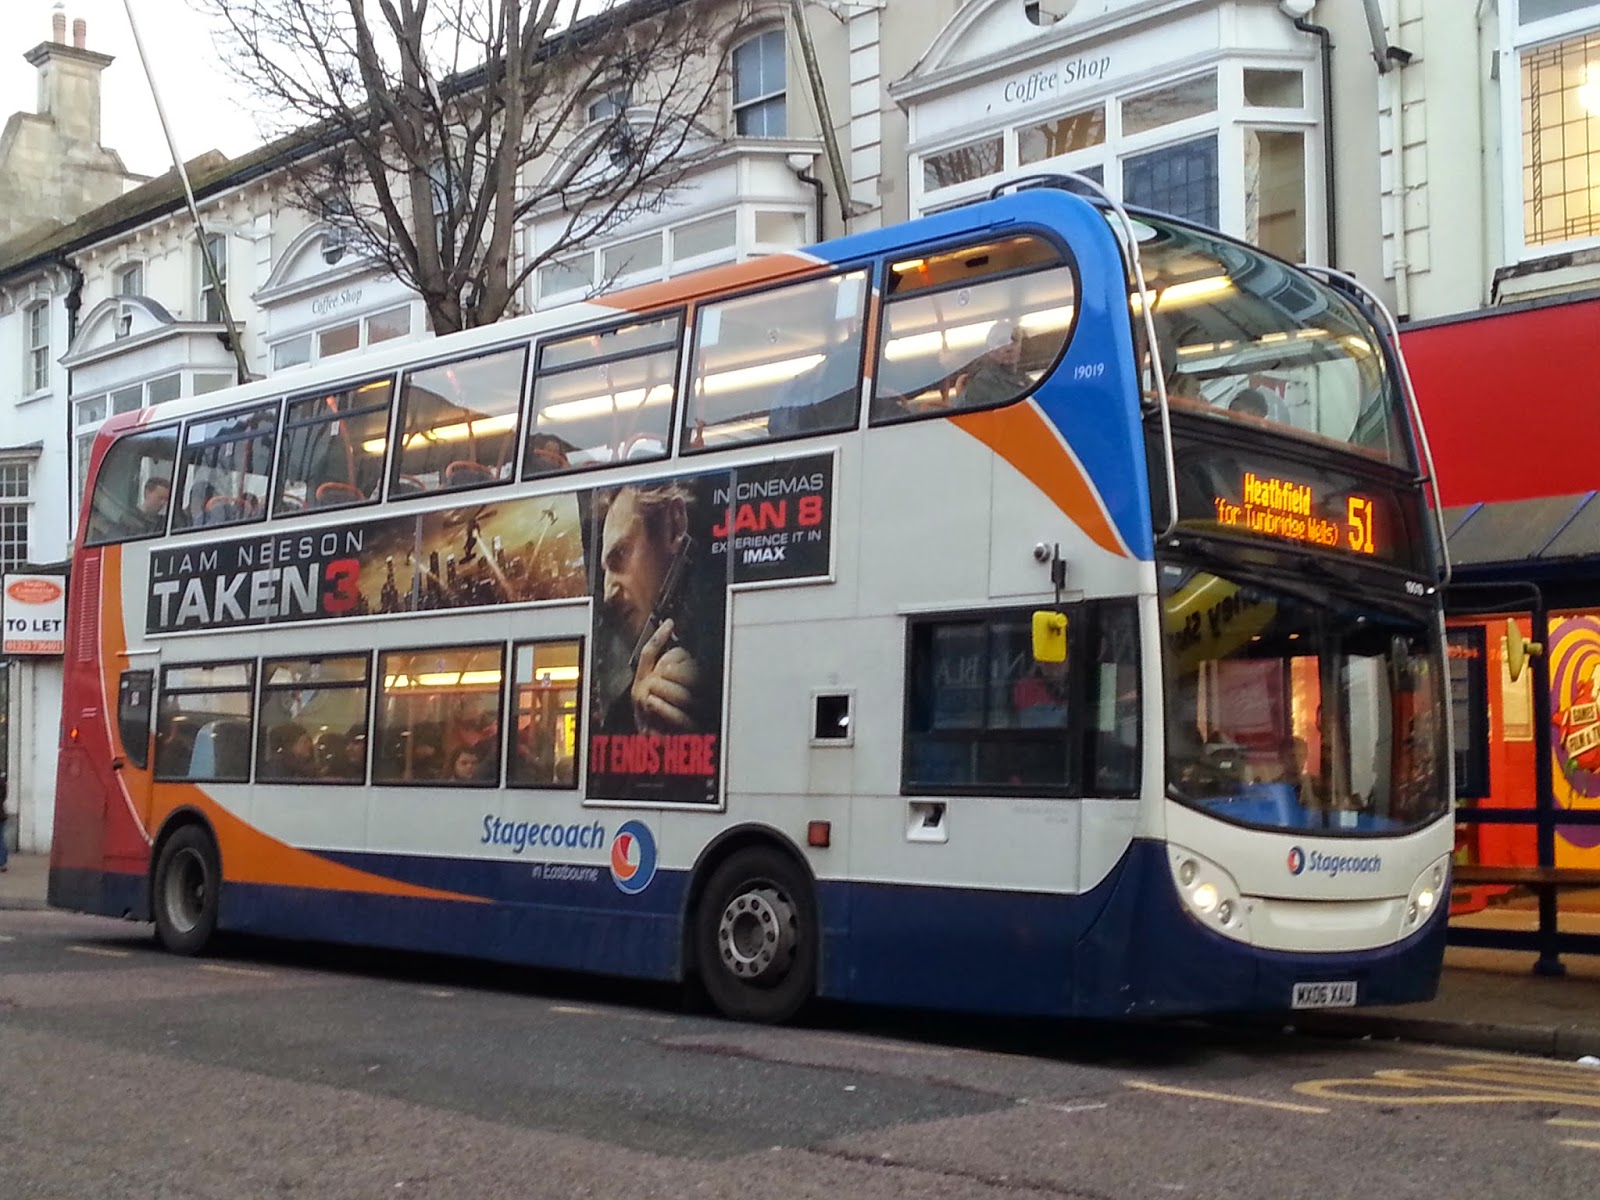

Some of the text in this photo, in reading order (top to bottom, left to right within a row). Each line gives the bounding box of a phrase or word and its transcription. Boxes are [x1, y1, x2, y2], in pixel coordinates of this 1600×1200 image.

[1004, 56, 1110, 103] Coffee Shop
[312, 289, 363, 314] Coffee Shop
[1074, 362, 1105, 380] 19019
[713, 473, 824, 505] IN CINEMAS
[1244, 472, 1312, 516] Heathfield
[712, 495, 823, 537] JAN 8
[1244, 503, 1306, 540] Tunbridge
[1348, 496, 1375, 554] 51
[153, 529, 363, 578] LIAM NEESON
[711, 529, 822, 554] EXERIENCE IT IN
[743, 546, 787, 564] IMAX
[6, 618, 62, 632] TO LET
[591, 734, 717, 775] IT ENDS HERE
[481, 813, 605, 854] Stagecoach
[531, 861, 599, 882] in Eastbourne
[1309, 849, 1382, 878] Stagecoach
